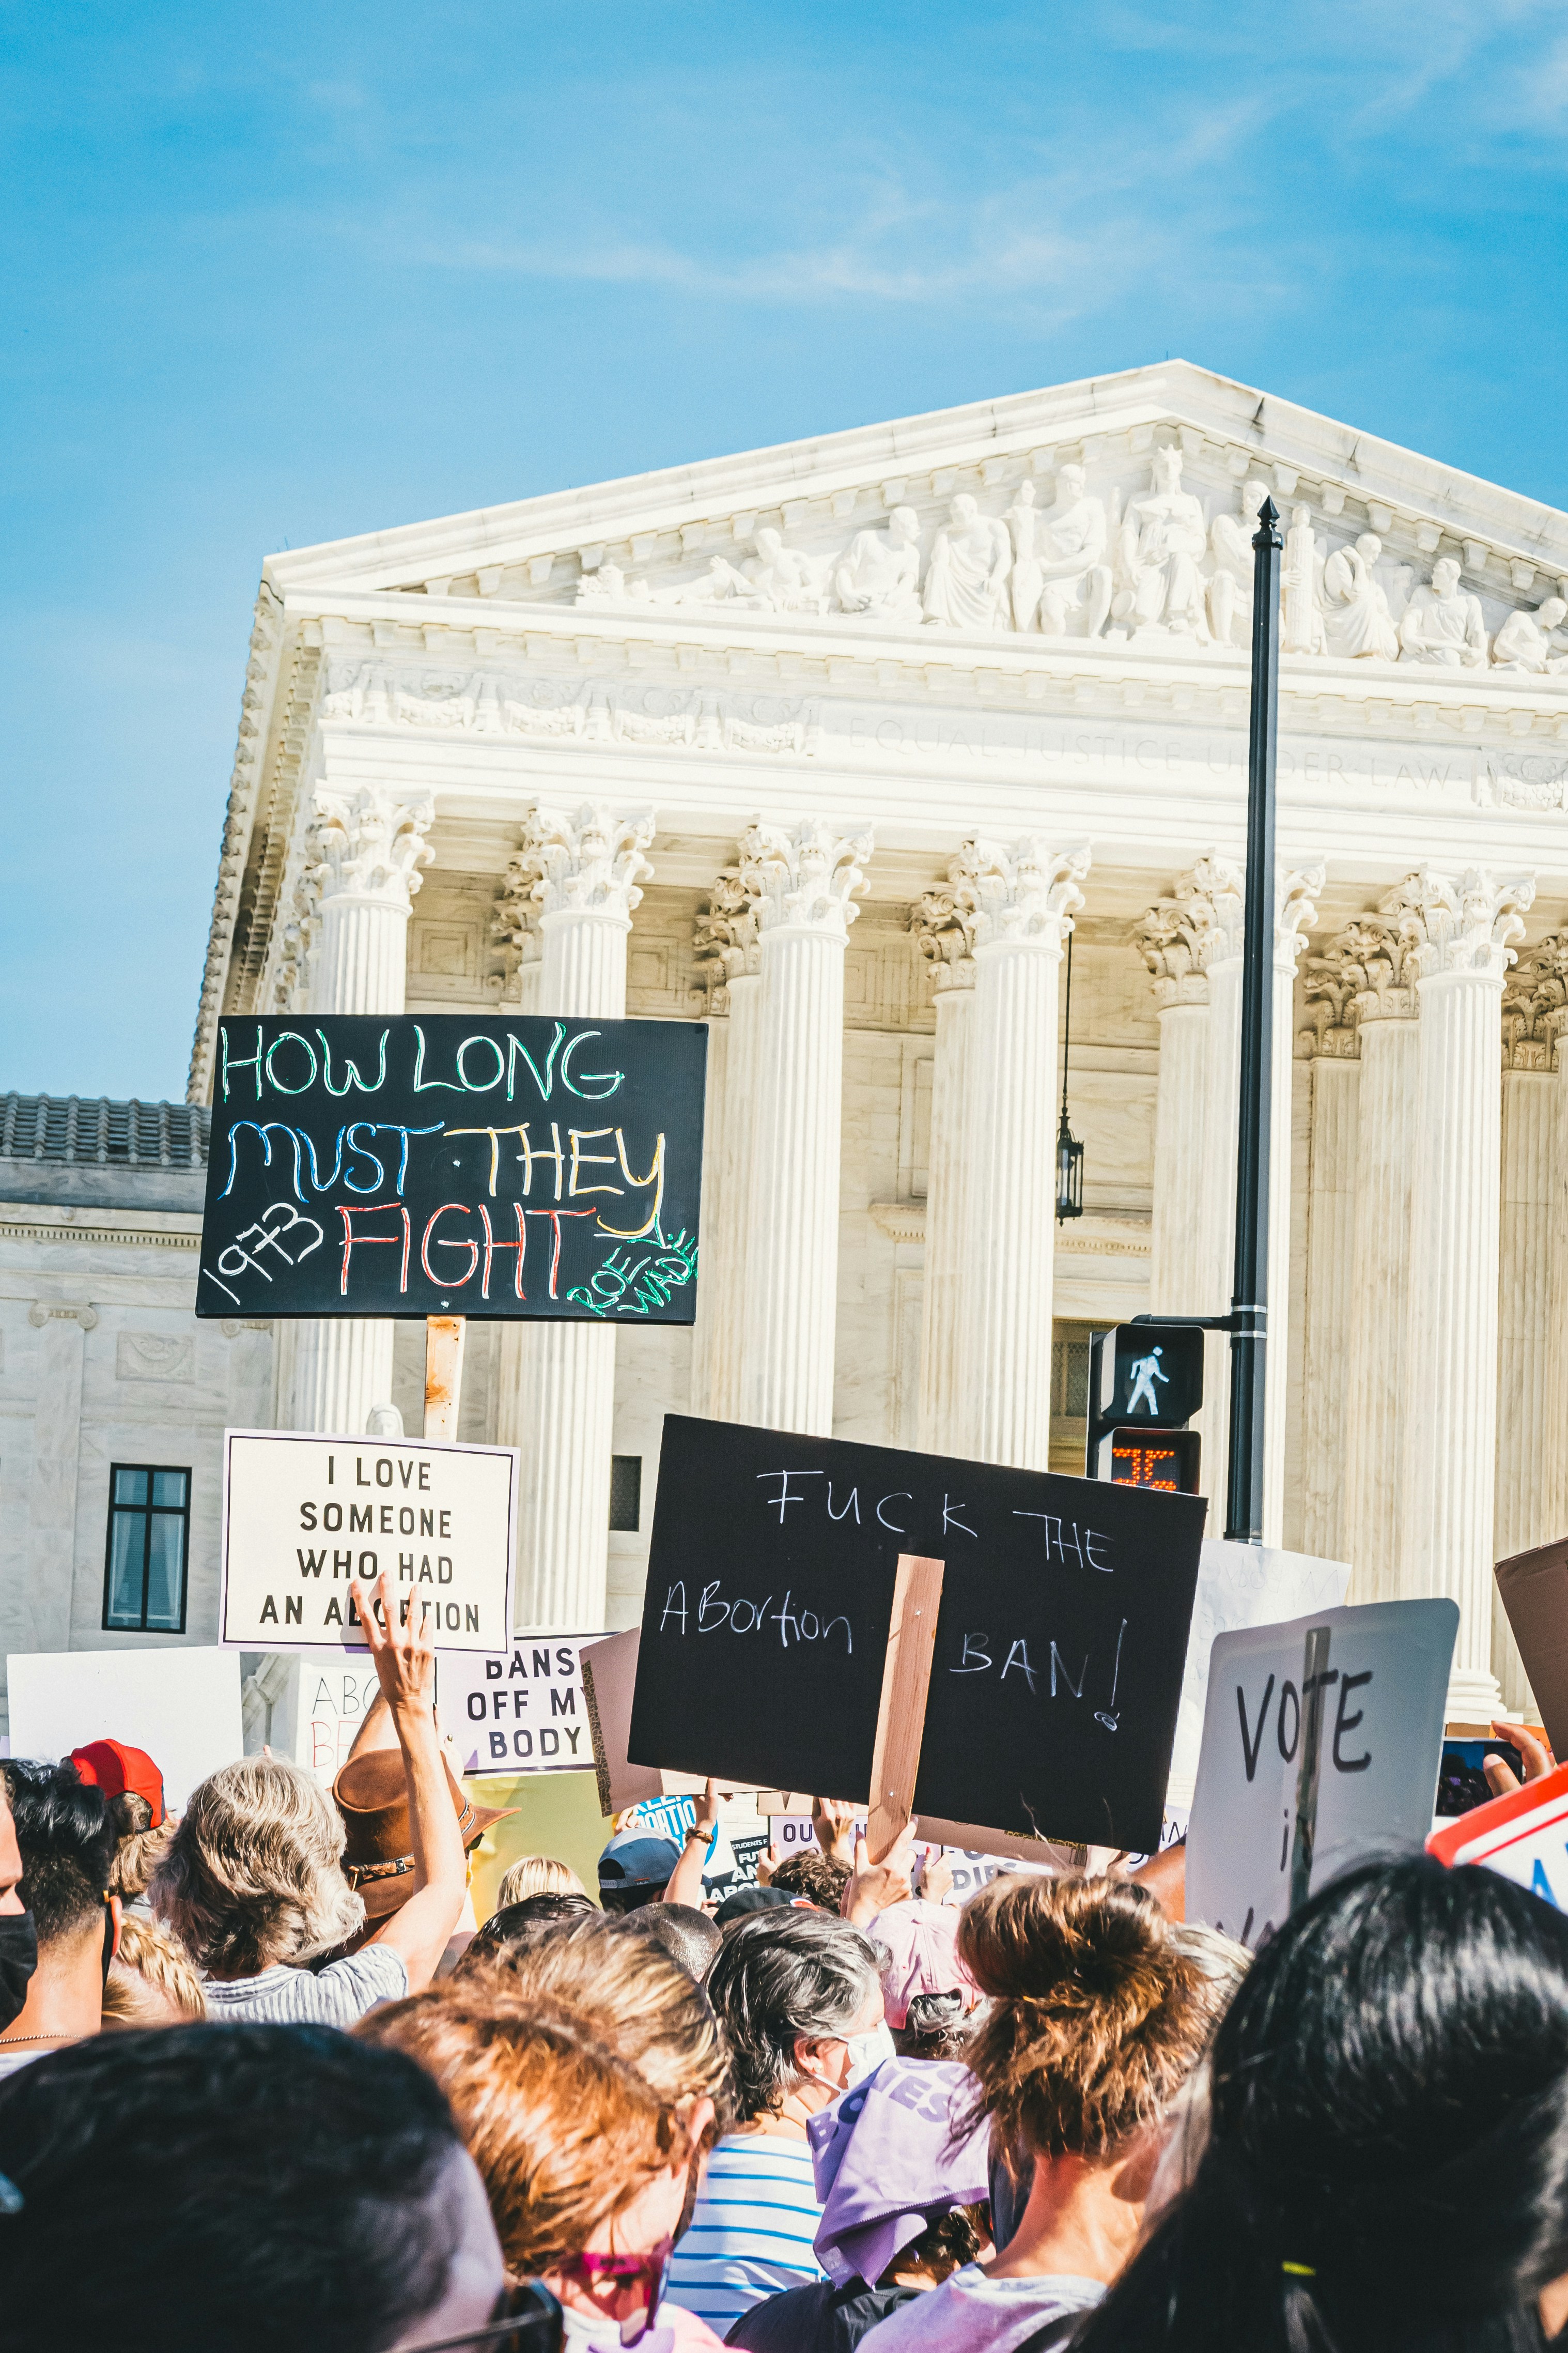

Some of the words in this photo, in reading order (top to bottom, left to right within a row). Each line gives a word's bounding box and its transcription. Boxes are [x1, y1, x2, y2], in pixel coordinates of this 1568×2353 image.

[850, 717, 998, 758] EQUAL
[1010, 725, 1182, 772] JUSTICE
[1371, 757, 1453, 791] LAW
[221, 1025, 390, 1102] HOW
[413, 1022, 625, 1102] LONG
[217, 1120, 445, 1204] MUST
[443, 1122, 665, 1238] THEY
[203, 1203, 324, 1305] 1973
[335, 1202, 596, 1300] FIGHT
[566, 1245, 651, 1317] ROE
[616, 1228, 699, 1314] WADE
[328, 1456, 334, 1484] I
[356, 1457, 431, 1491] LOVE
[300, 1502, 452, 1539] SOMEONE
[756, 1470, 978, 1537] FUCK
[1013, 1511, 1115, 1573] THE
[297, 1549, 378, 1580] WHO
[399, 1552, 453, 1584] HAD
[259, 1595, 302, 1624] AN
[486, 1648, 575, 1680] BANS
[950, 1618, 1127, 1732] BAN!
[467, 1690, 529, 1721] OFF
[550, 1687, 586, 1716] M
[1237, 1669, 1373, 1782] VOTE
[489, 1727, 581, 1759] BODY
[731, 1863, 760, 1883] AN
[732, 1840, 763, 1850] STUDENTS
